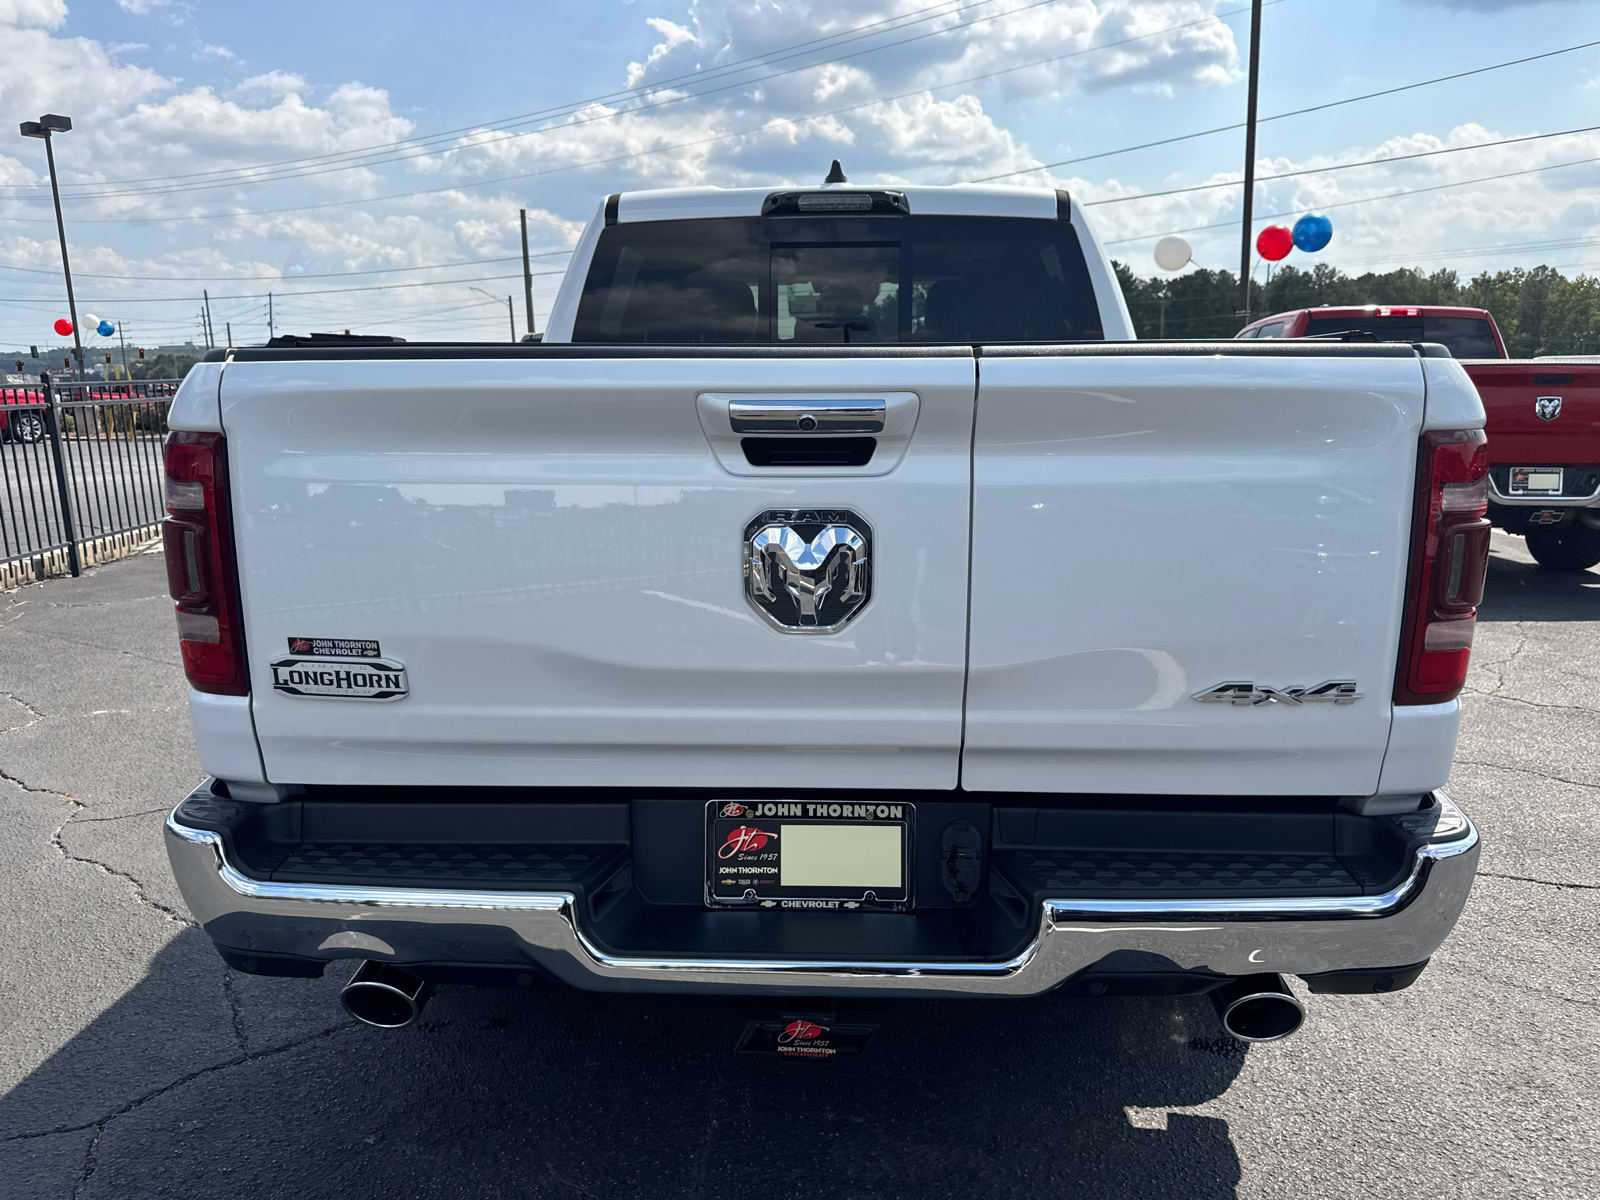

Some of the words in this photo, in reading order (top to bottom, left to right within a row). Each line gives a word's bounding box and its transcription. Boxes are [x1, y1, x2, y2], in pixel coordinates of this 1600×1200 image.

[769, 510, 848, 523] RAM
[312, 639, 333, 648] JOHN
[334, 640, 378, 650] THORNTON
[313, 647, 362, 656] CHEVROLET
[755, 803, 802, 816] JOHN
[806, 804, 903, 818] THORNTON
[738, 853, 758, 861] Since
[760, 853, 778, 861] 1957
[719, 866, 738, 874] JOHN
[738, 866, 778, 874] THORNTON
[781, 900, 840, 909] CHEVROLET
[797, 1046, 836, 1054] THORNTON
